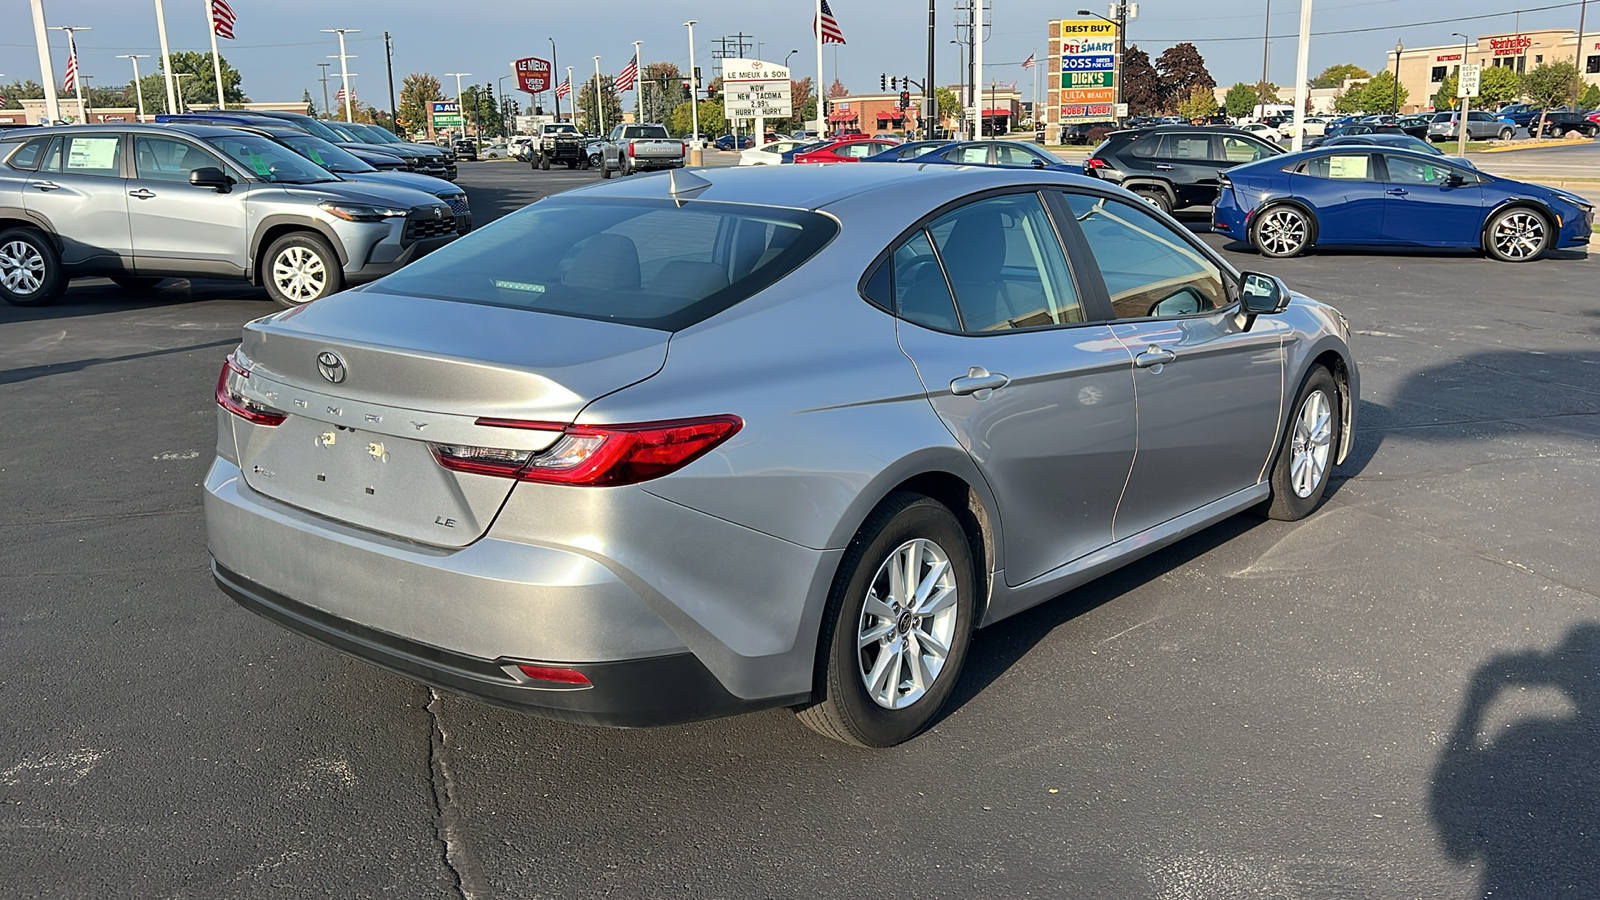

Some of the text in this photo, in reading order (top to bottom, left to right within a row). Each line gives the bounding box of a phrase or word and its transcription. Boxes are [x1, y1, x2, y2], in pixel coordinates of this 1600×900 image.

[1065, 25, 1089, 33] BEST
[1490, 35, 1532, 50] Steinhafels
[518, 59, 548, 71] LE MIEUX
[1062, 58, 1092, 69] ROSS
[739, 71, 761, 79] MIEUX
[1071, 73, 1104, 84] DICK'S
[1064, 91, 1086, 99] ULTA
[443, 104, 462, 112] ALD
[1061, 106, 1086, 116] HOBBY
[1088, 105, 1111, 115] LOBBY
[434, 515, 457, 528] LE
